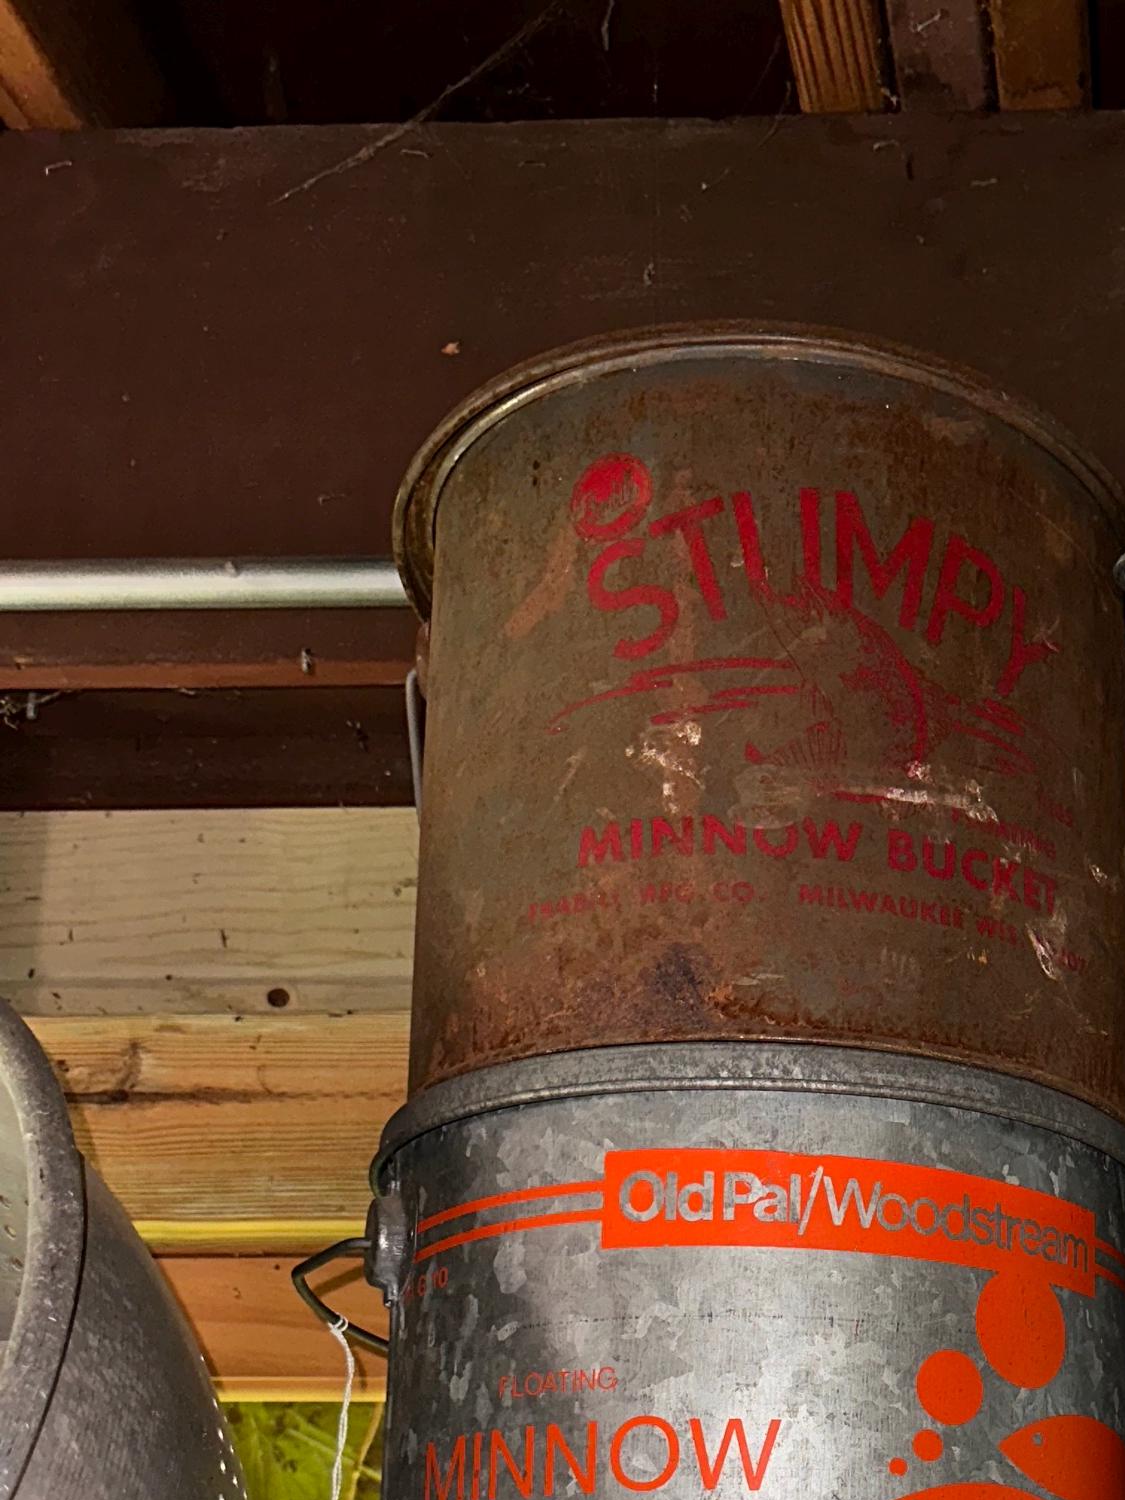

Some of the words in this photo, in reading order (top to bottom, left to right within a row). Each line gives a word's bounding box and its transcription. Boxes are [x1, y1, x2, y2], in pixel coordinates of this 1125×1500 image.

[587, 487, 1060, 697] STUMPY
[577, 813, 864, 868] MINNOW
[886, 828, 1058, 914] BUCKET
[799, 882, 965, 930] MILWAUKEE
[618, 1170, 716, 1223] Old
[498, 1365, 618, 1400] FLOATING
